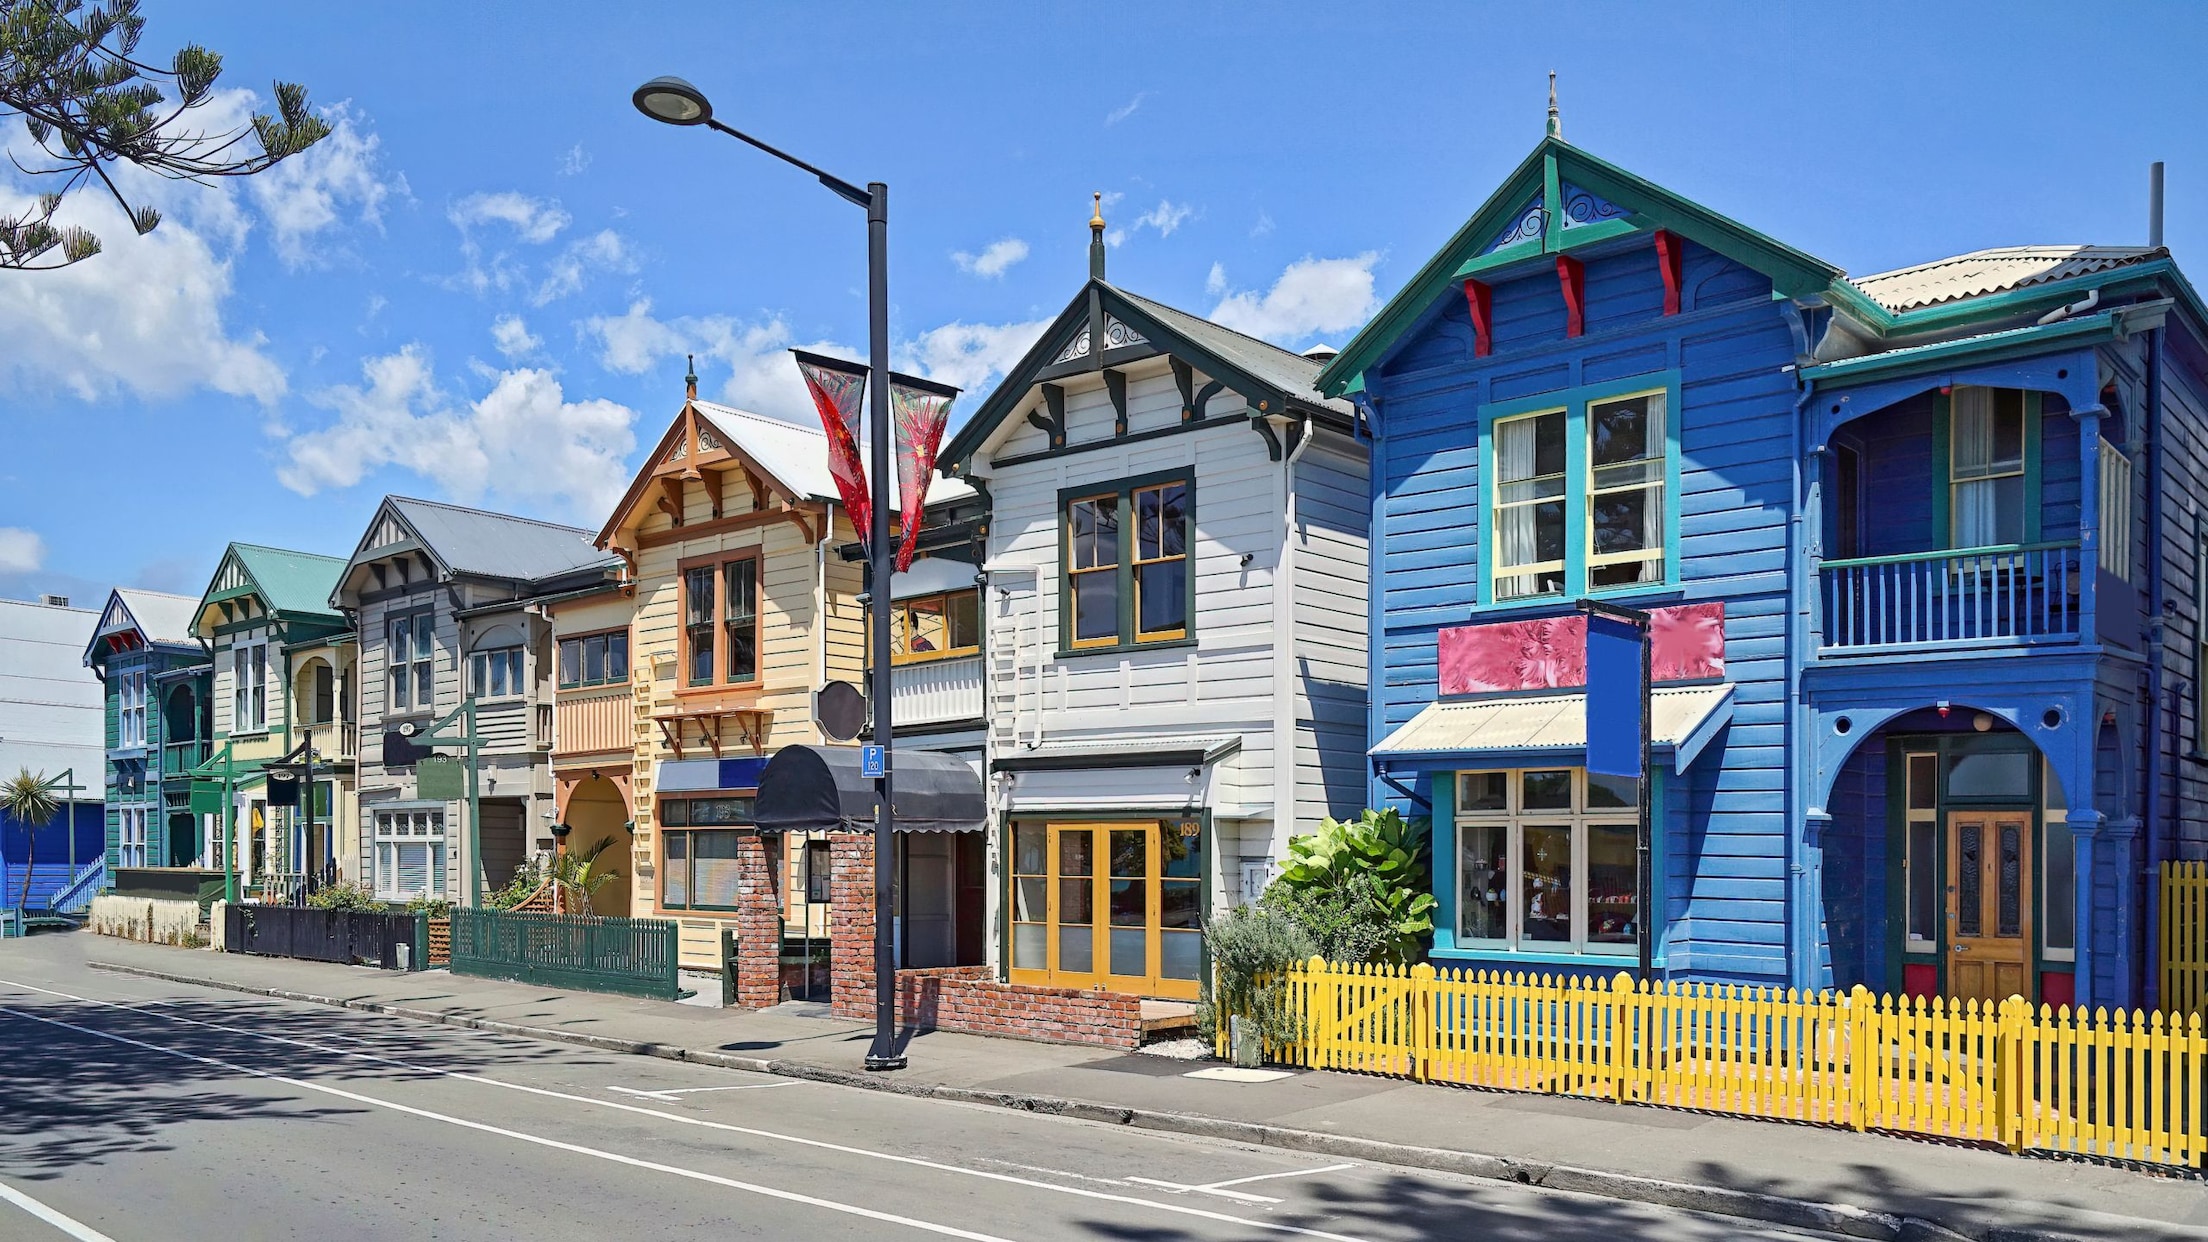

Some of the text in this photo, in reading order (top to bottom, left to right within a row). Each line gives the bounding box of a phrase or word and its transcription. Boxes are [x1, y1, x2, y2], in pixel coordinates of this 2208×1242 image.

[869, 748, 877, 760] P
[867, 761, 878, 770] 120
[1179, 822, 1200, 837] 189
